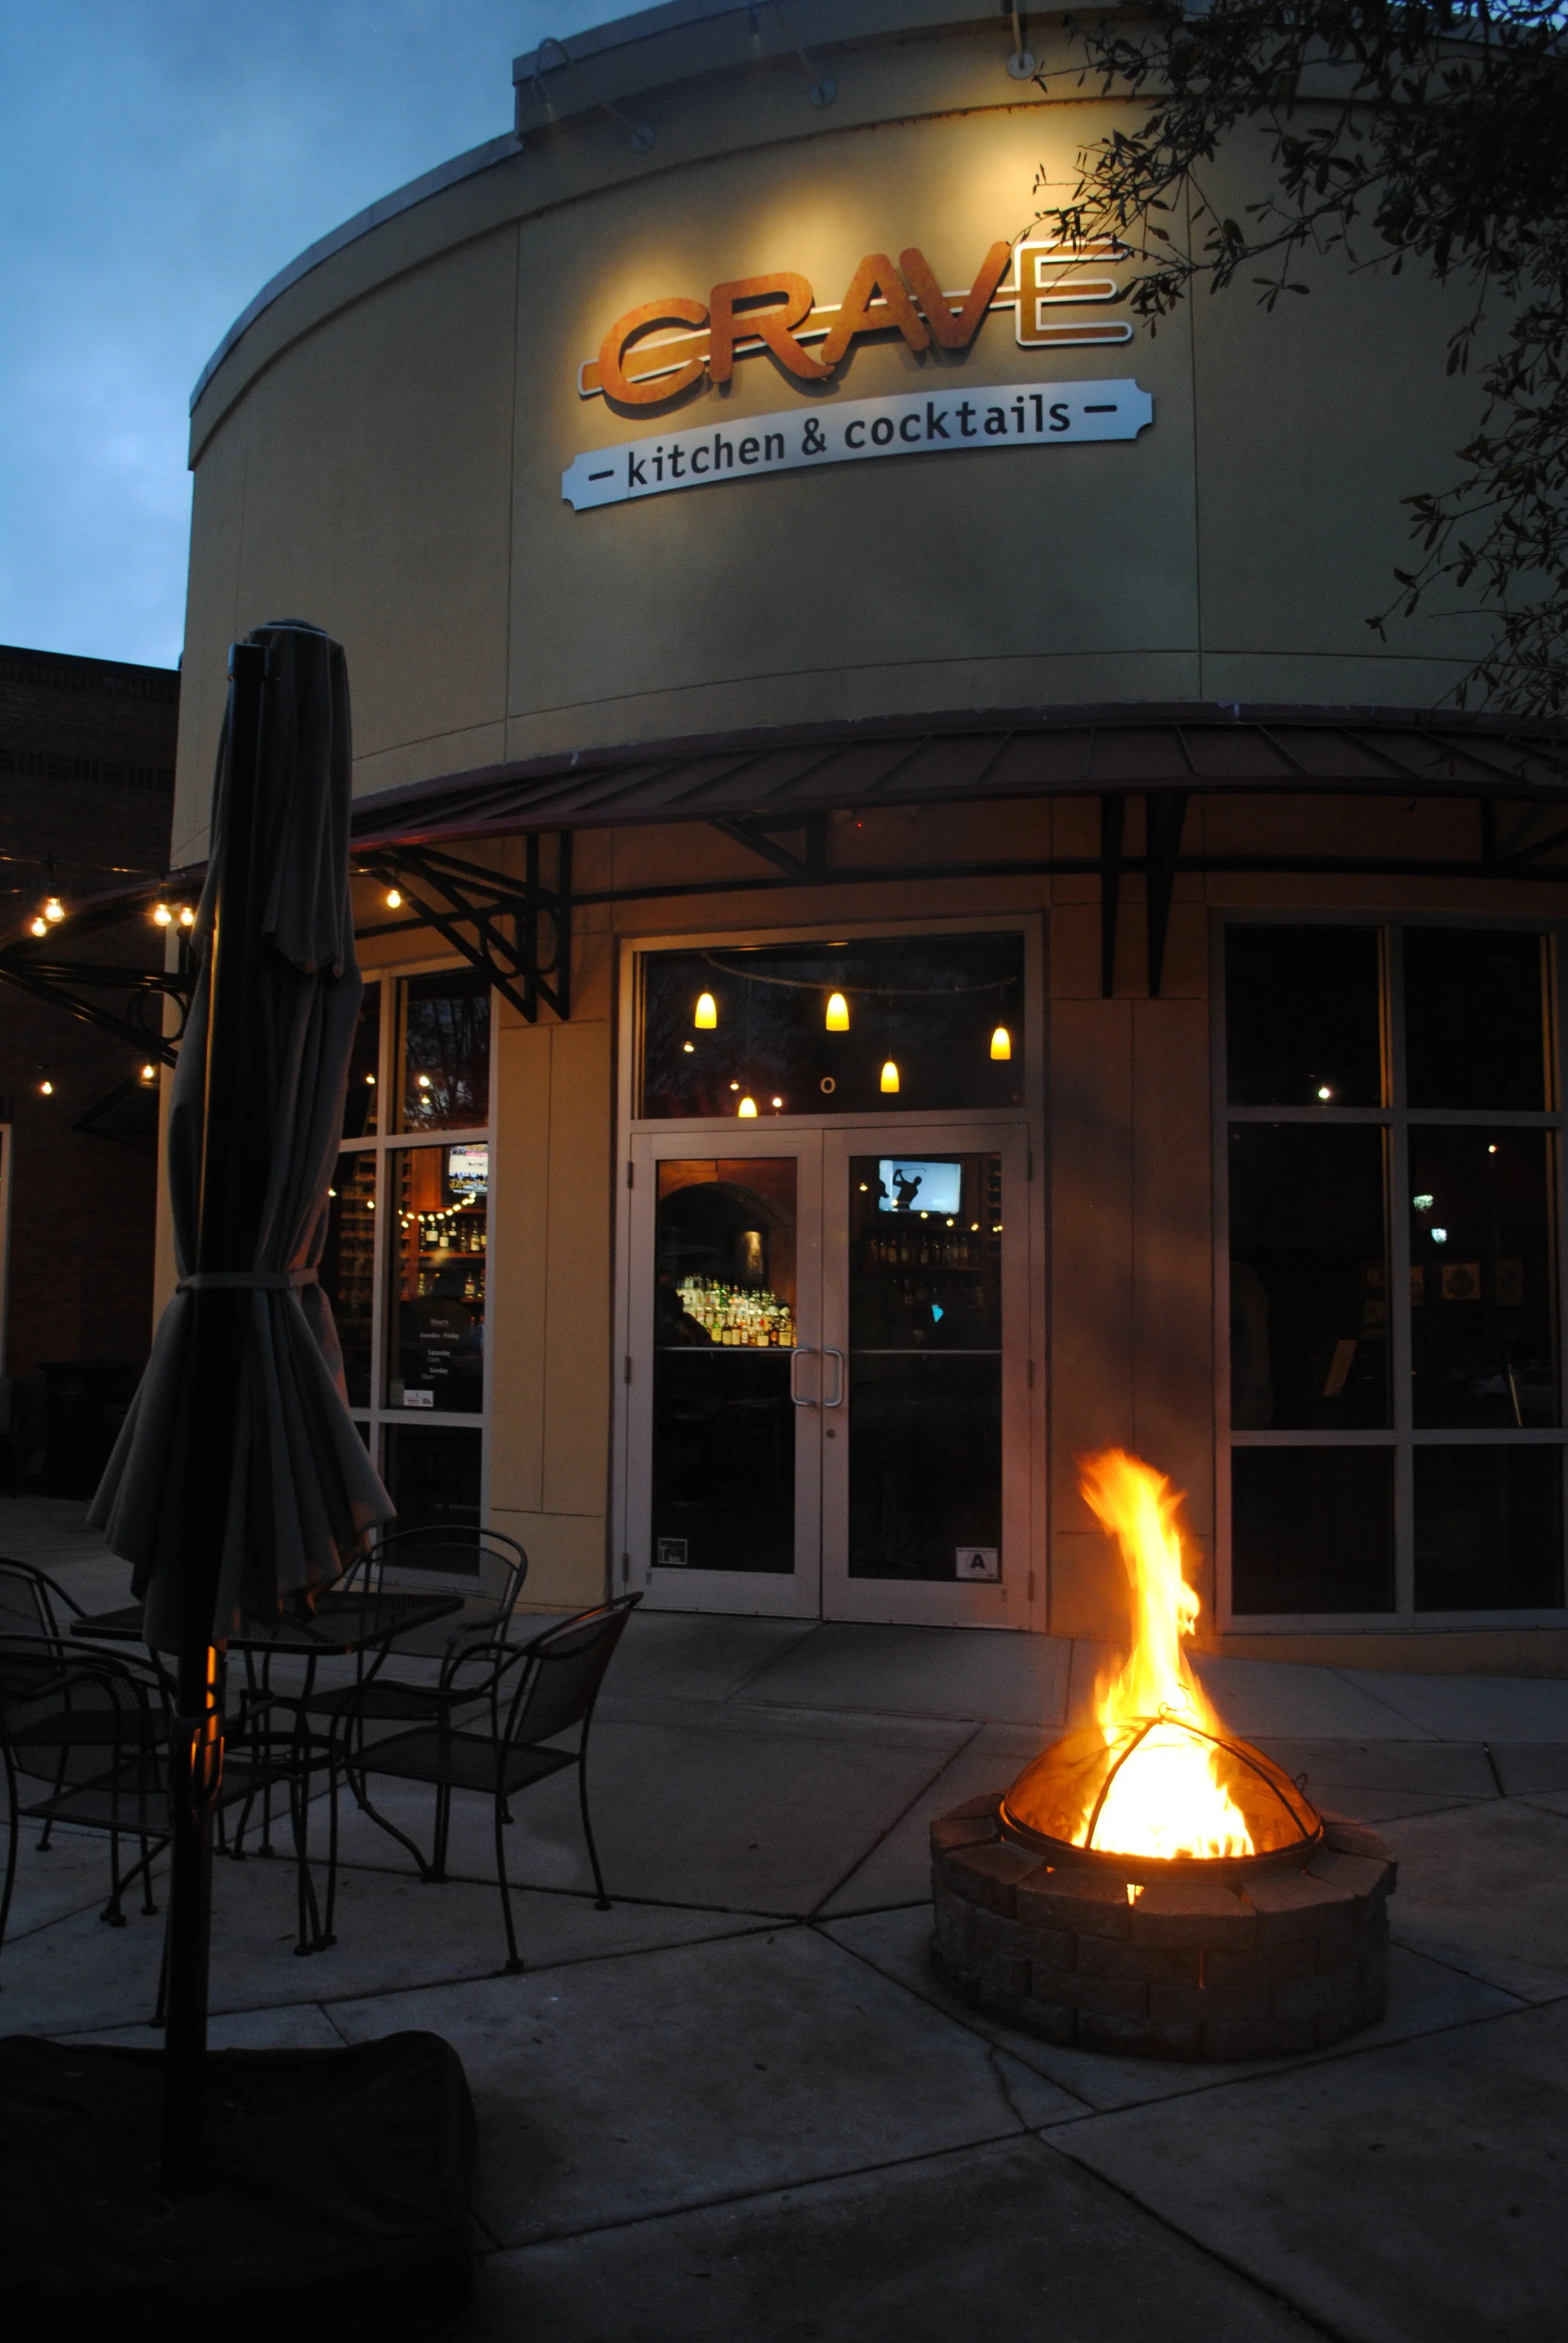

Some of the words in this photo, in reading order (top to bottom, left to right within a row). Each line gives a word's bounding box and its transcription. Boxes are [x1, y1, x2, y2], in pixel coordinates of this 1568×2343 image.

[598, 240, 1133, 405] CRAVE
[628, 433, 785, 487] kitchen
[802, 418, 827, 455] &
[845, 394, 1071, 449] cocktails
[971, 1554, 985, 1569] A
